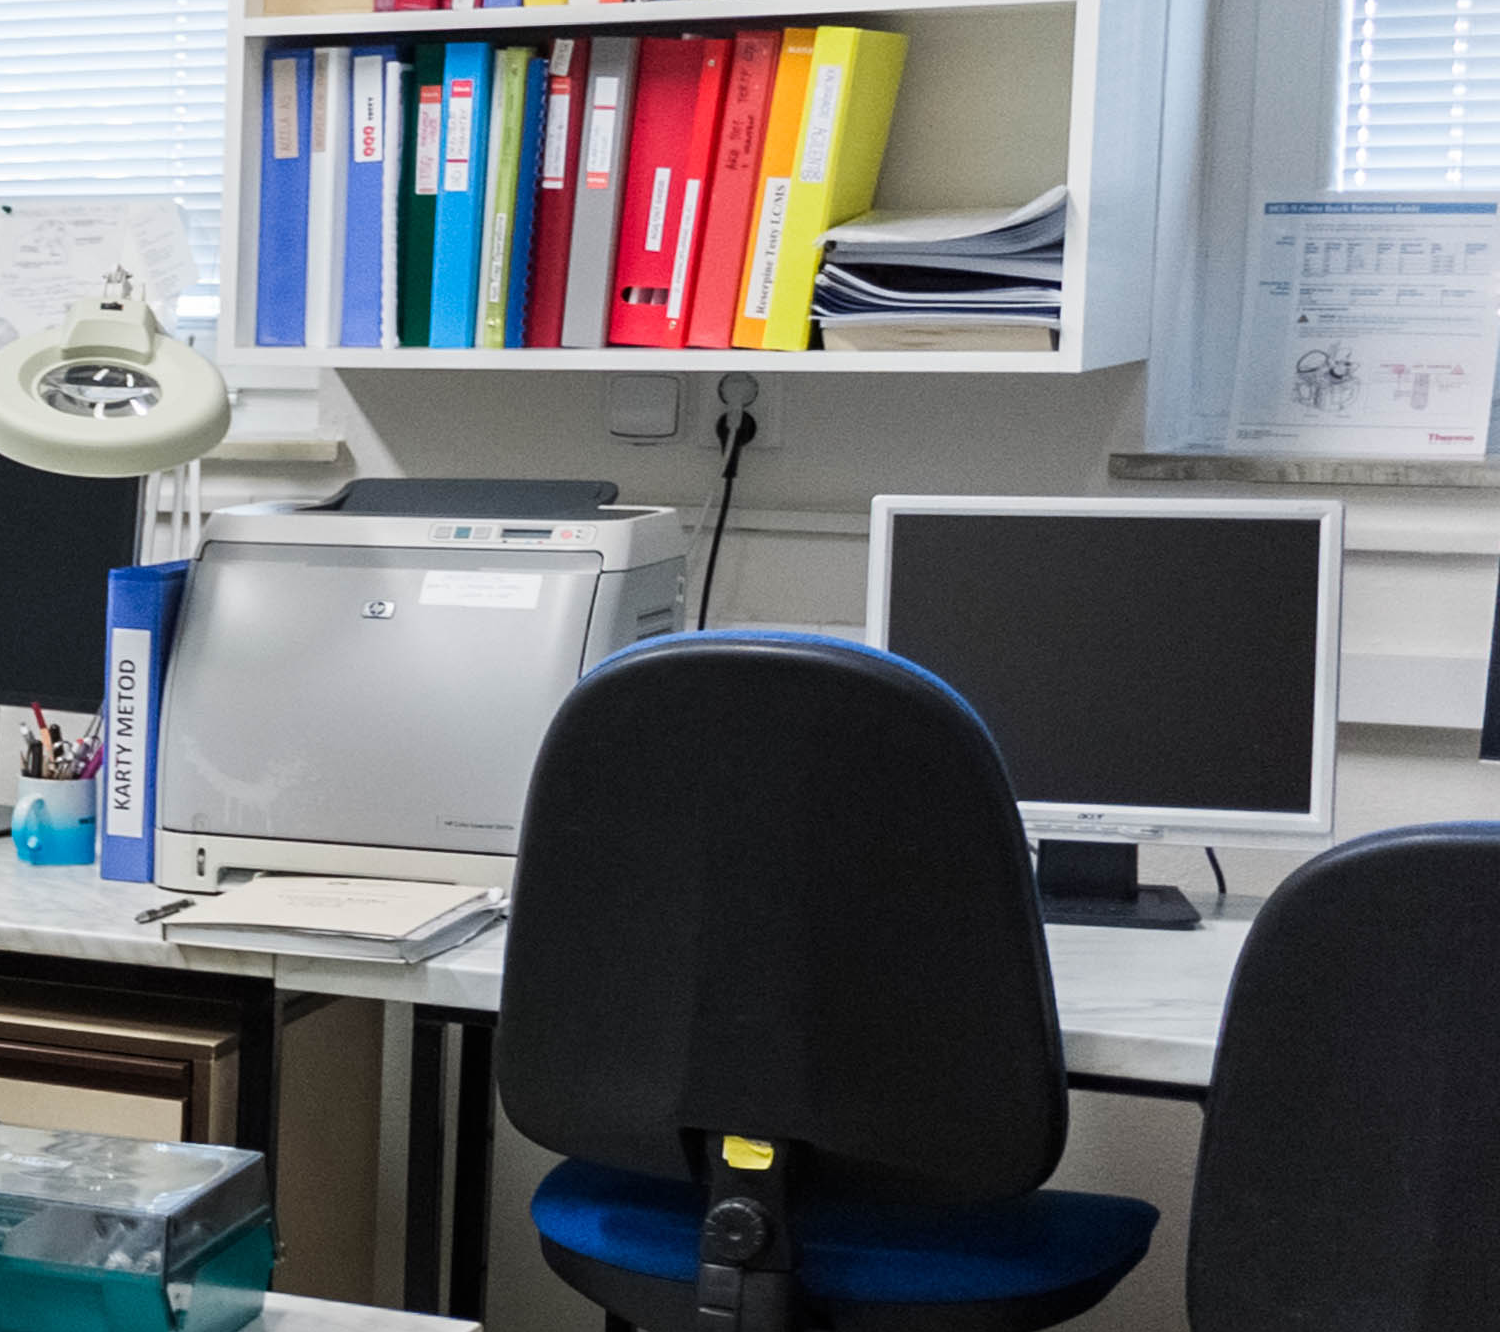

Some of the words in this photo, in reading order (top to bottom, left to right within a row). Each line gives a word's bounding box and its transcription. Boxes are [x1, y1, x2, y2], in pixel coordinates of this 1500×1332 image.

[770, 184, 787, 225] LC/MS
[764, 229, 781, 257] Testy
[755, 260, 774, 315] Reserpine
[115, 657, 137, 736] METOD
[113, 741, 134, 812] KARTY
